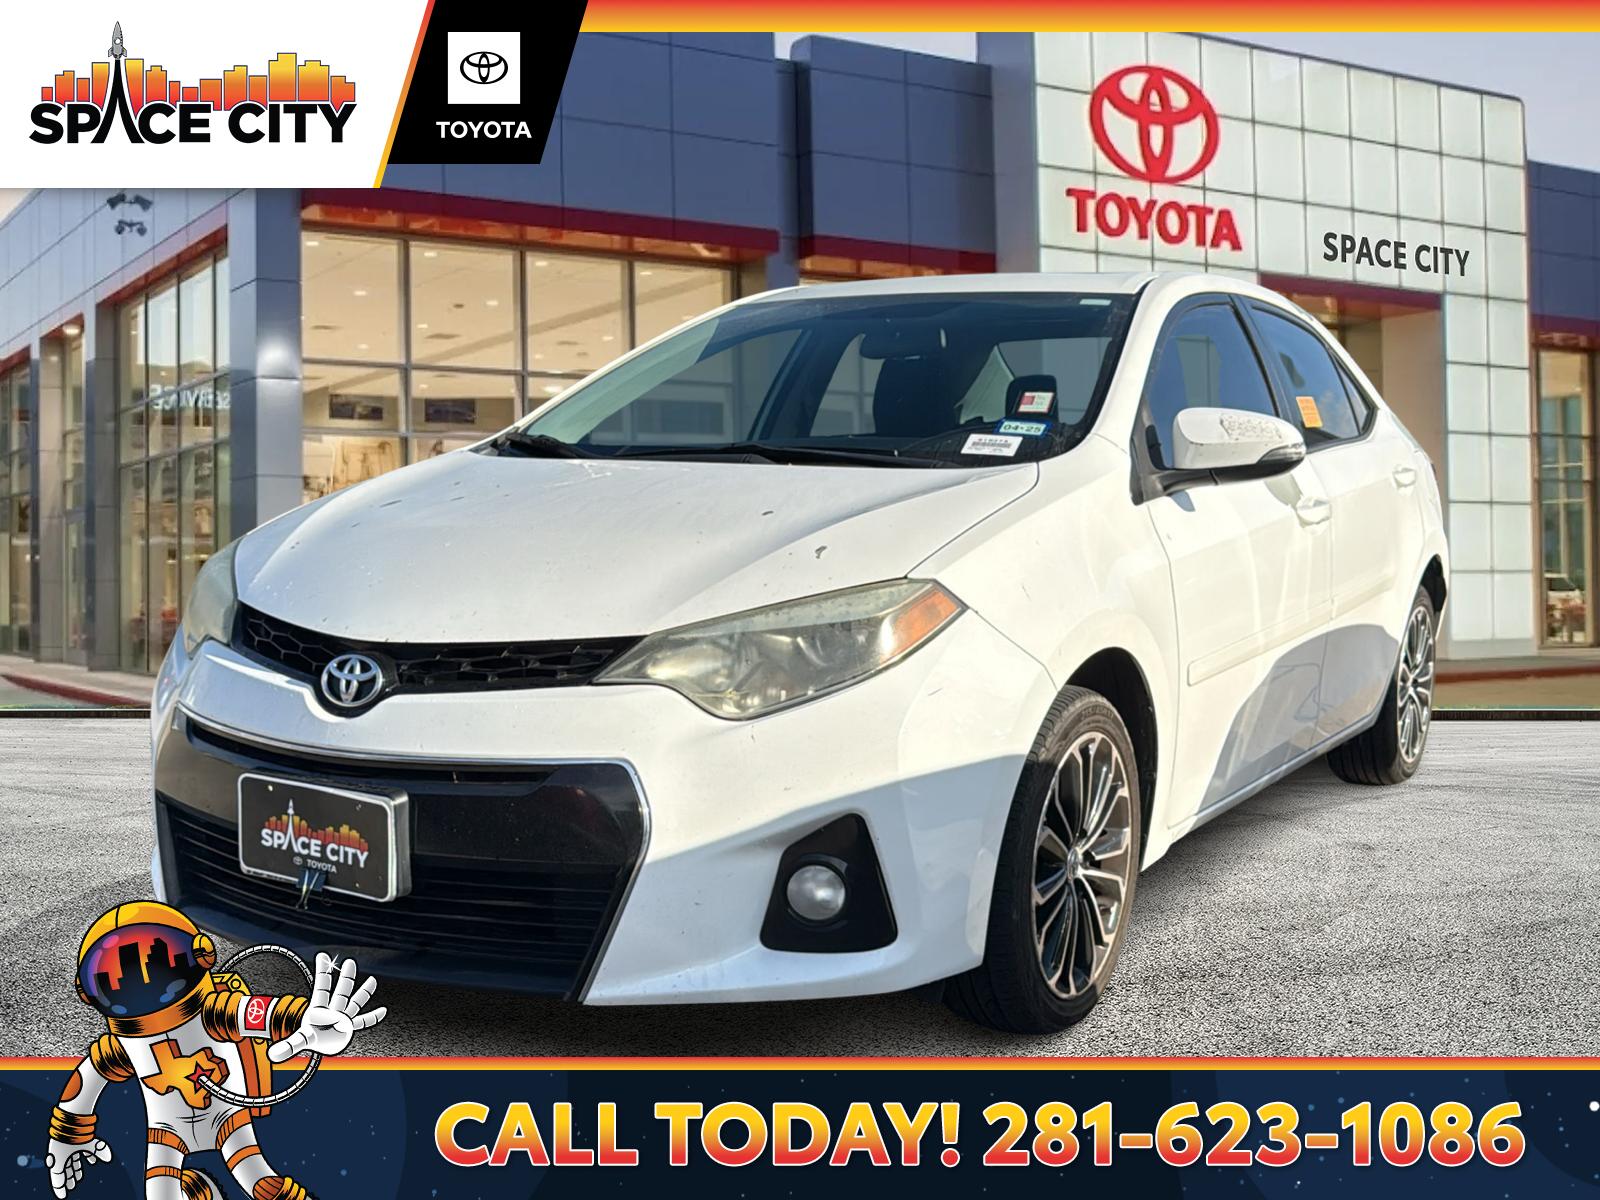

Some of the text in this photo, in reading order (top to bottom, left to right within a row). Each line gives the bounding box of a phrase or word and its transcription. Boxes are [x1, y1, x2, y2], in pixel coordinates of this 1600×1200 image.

[1066, 187, 1242, 251] TOYOTA
[1323, 232, 1470, 277] SPACE CITY
[261, 828, 369, 868] SPACE CITY
[306, 859, 337, 873] TOYOTA
